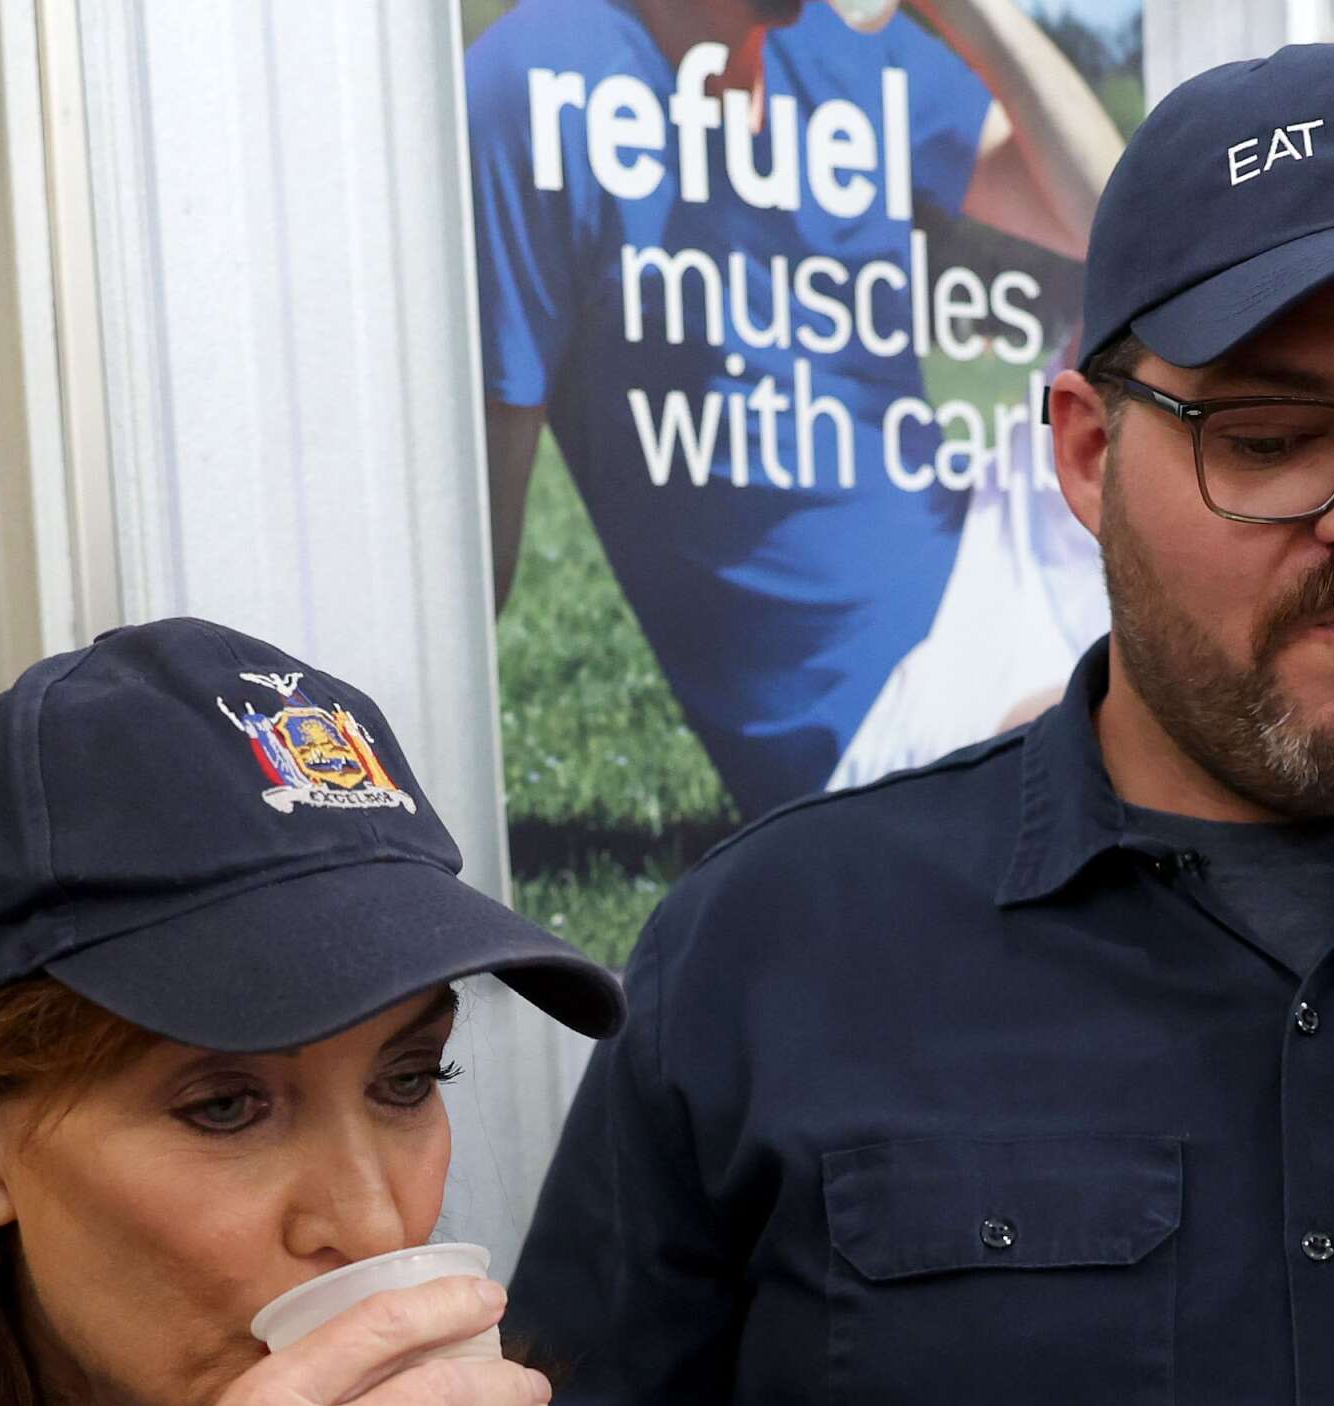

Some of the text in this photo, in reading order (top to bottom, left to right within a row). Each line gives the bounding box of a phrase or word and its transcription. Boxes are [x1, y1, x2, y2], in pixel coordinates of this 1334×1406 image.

[528, 41, 911, 221] refuel
[1228, 119, 1324, 186] EAT
[622, 230, 1042, 363] muscles
[628, 354, 853, 490] with
